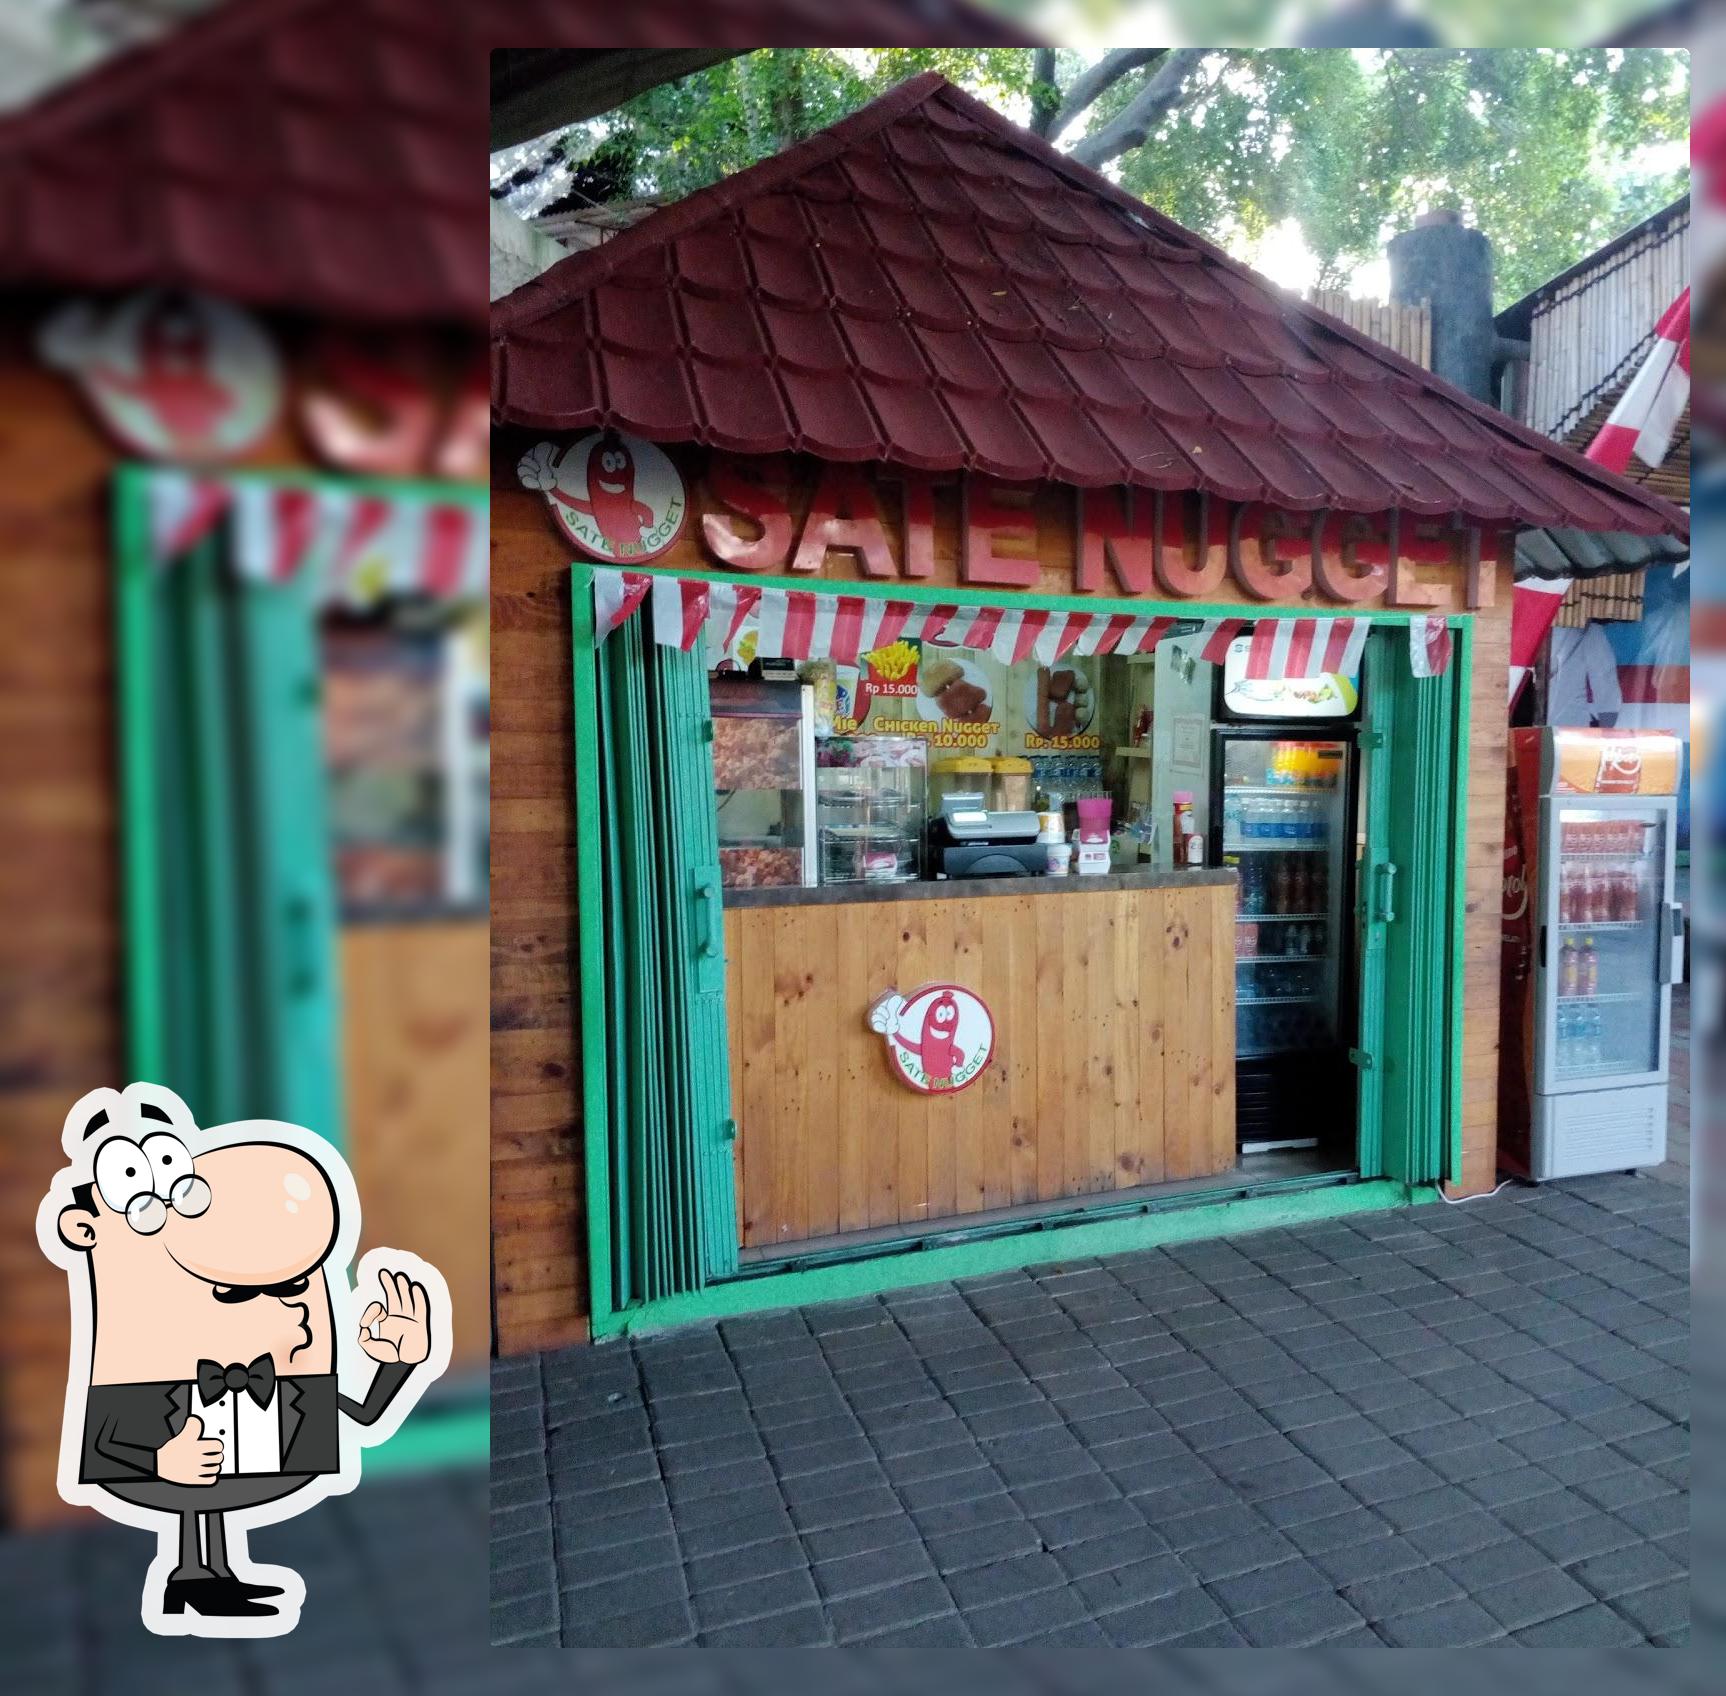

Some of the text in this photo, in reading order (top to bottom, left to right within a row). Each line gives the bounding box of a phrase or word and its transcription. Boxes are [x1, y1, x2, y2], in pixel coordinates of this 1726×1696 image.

[565, 497, 683, 556] SATE NUGGET
[702, 458, 1040, 586] SATE
[865, 682, 918, 695] Rp 15.000
[934, 733, 988, 748] 10.000
[1050, 734, 1102, 750] 15.000
[900, 1051, 930, 1086] SATE
